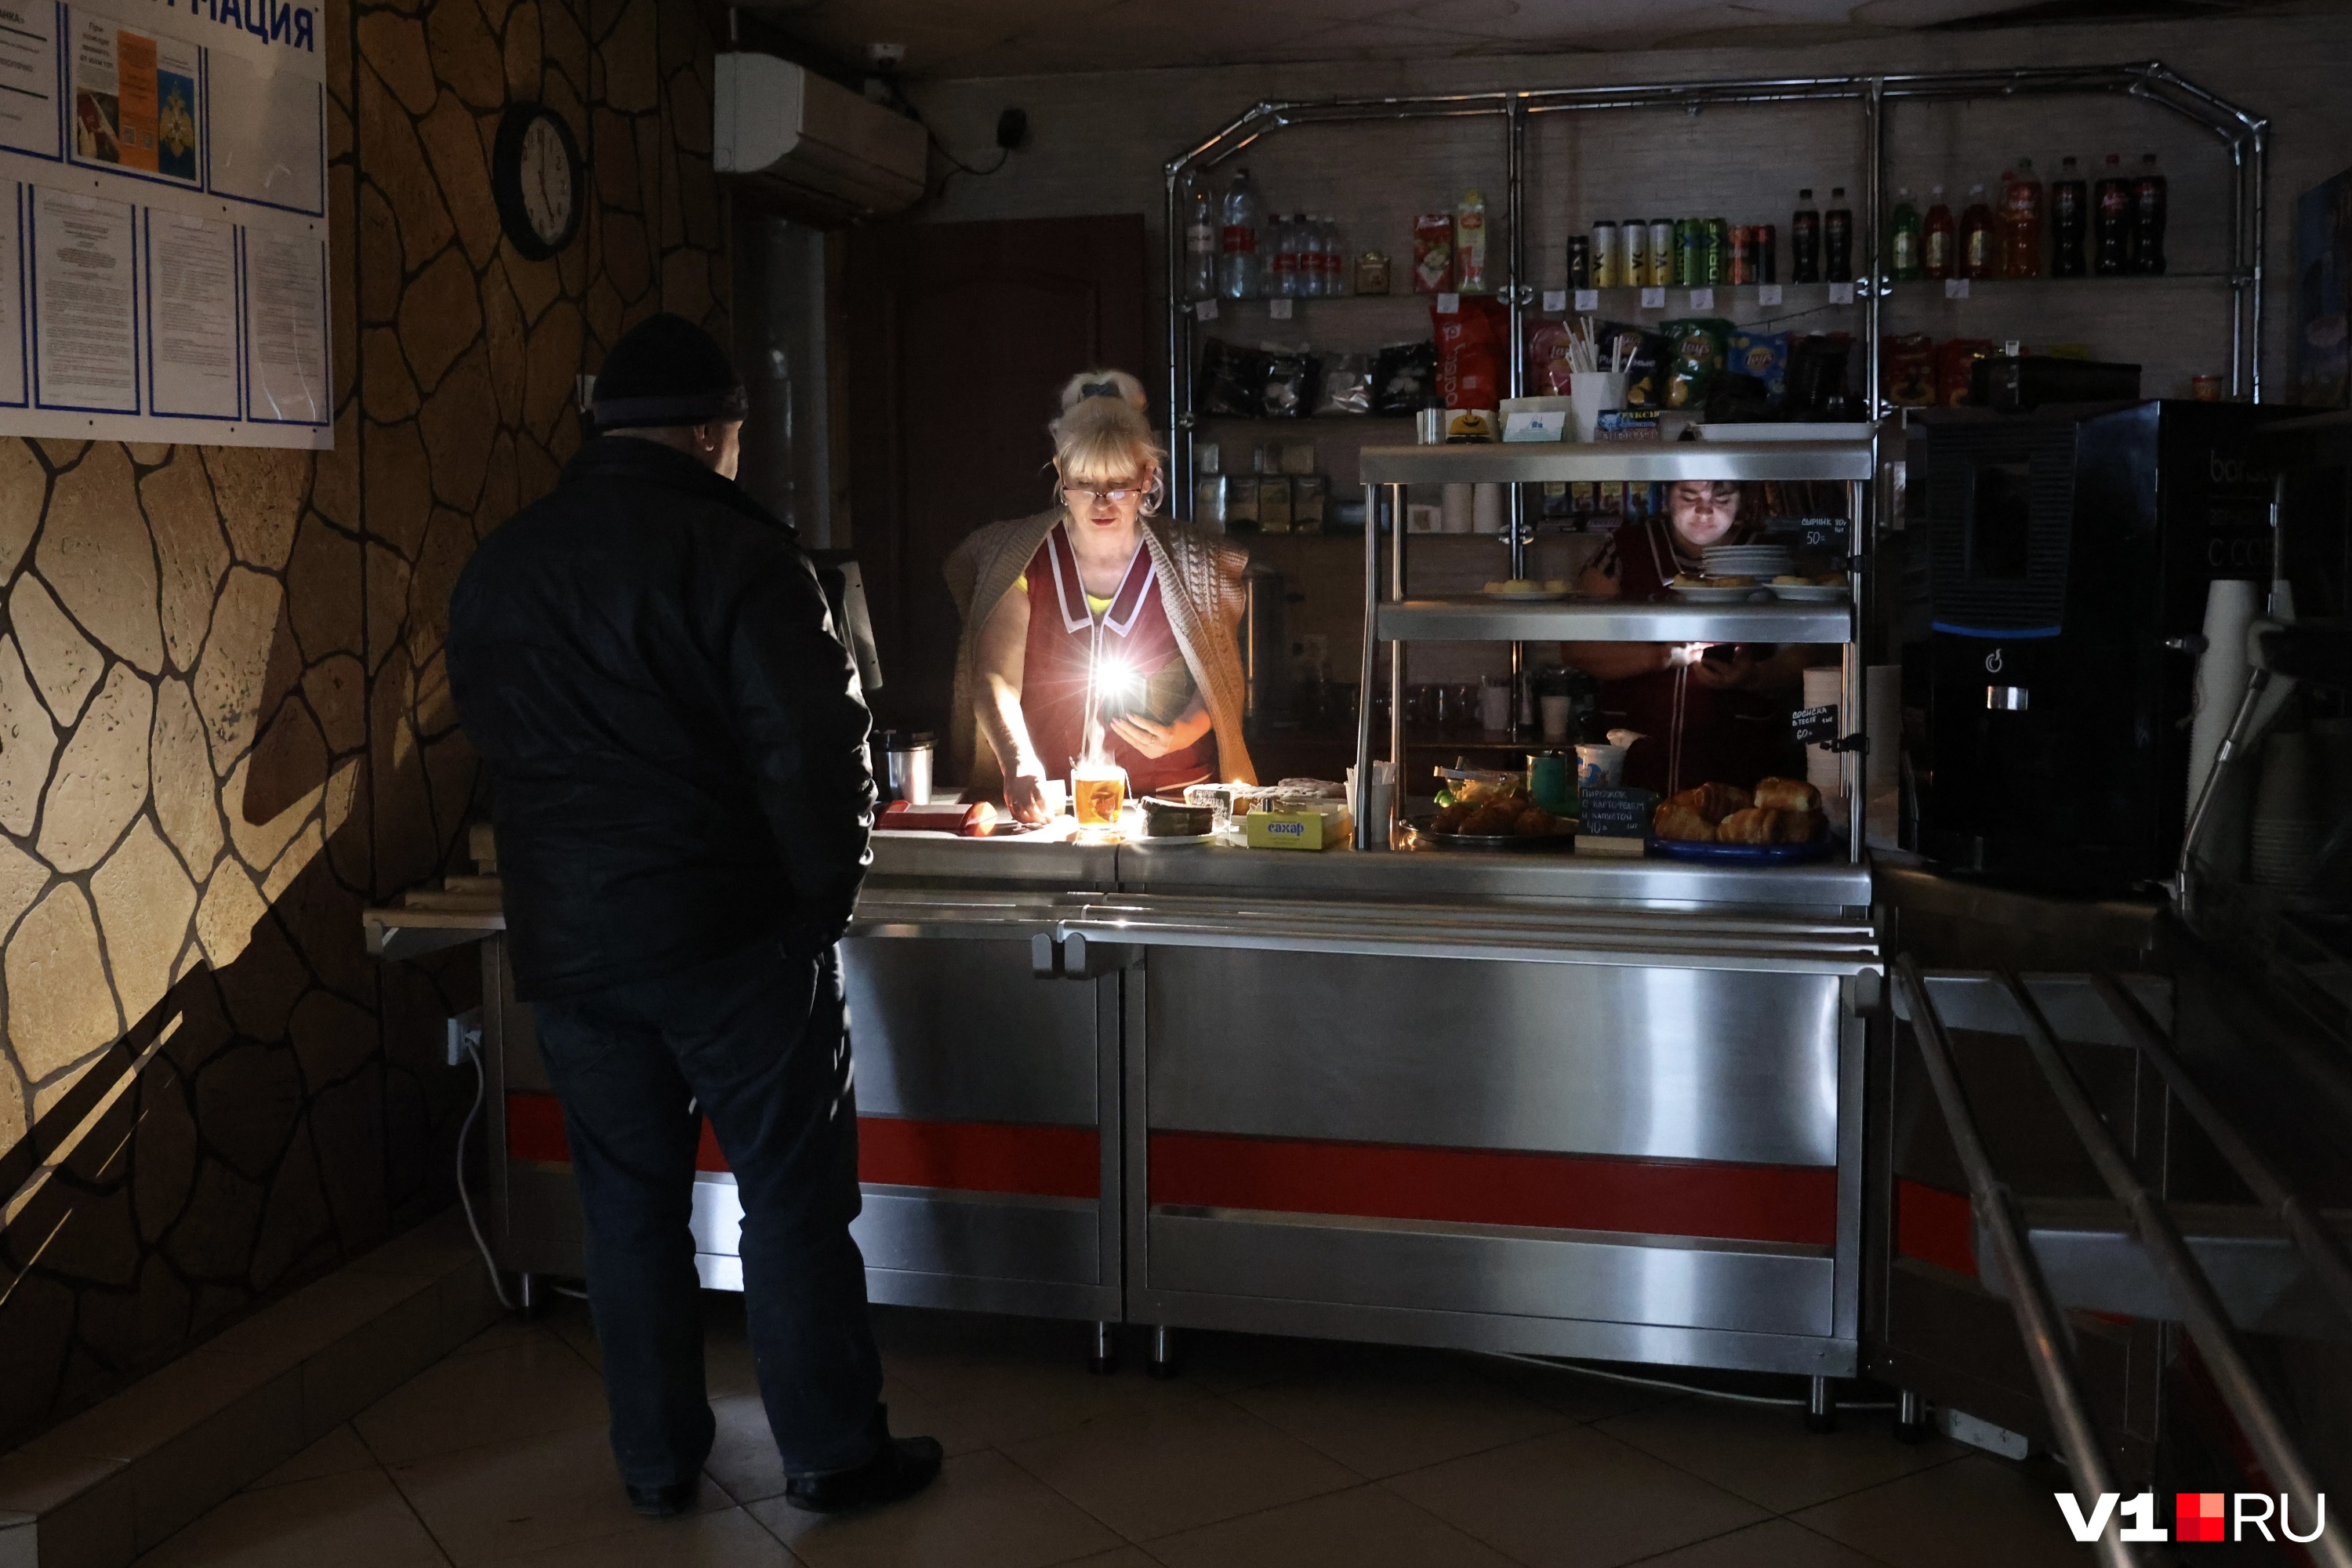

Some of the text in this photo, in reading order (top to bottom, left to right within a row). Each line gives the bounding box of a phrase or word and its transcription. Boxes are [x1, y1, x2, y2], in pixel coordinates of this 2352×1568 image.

[1708, 221, 1719, 281] DRIVE
[1792, 707, 1828, 720] СОСИСКА
[1798, 716, 1817, 725] ТЕСТЕ
[1582, 789, 1628, 799] ПИРОЖОК
[1593, 800, 1644, 811] КАРТОФЕЛЕМ
[1592, 811, 1632, 821] КАПУСТОЙ
[1268, 822, 1305, 837] сахар
